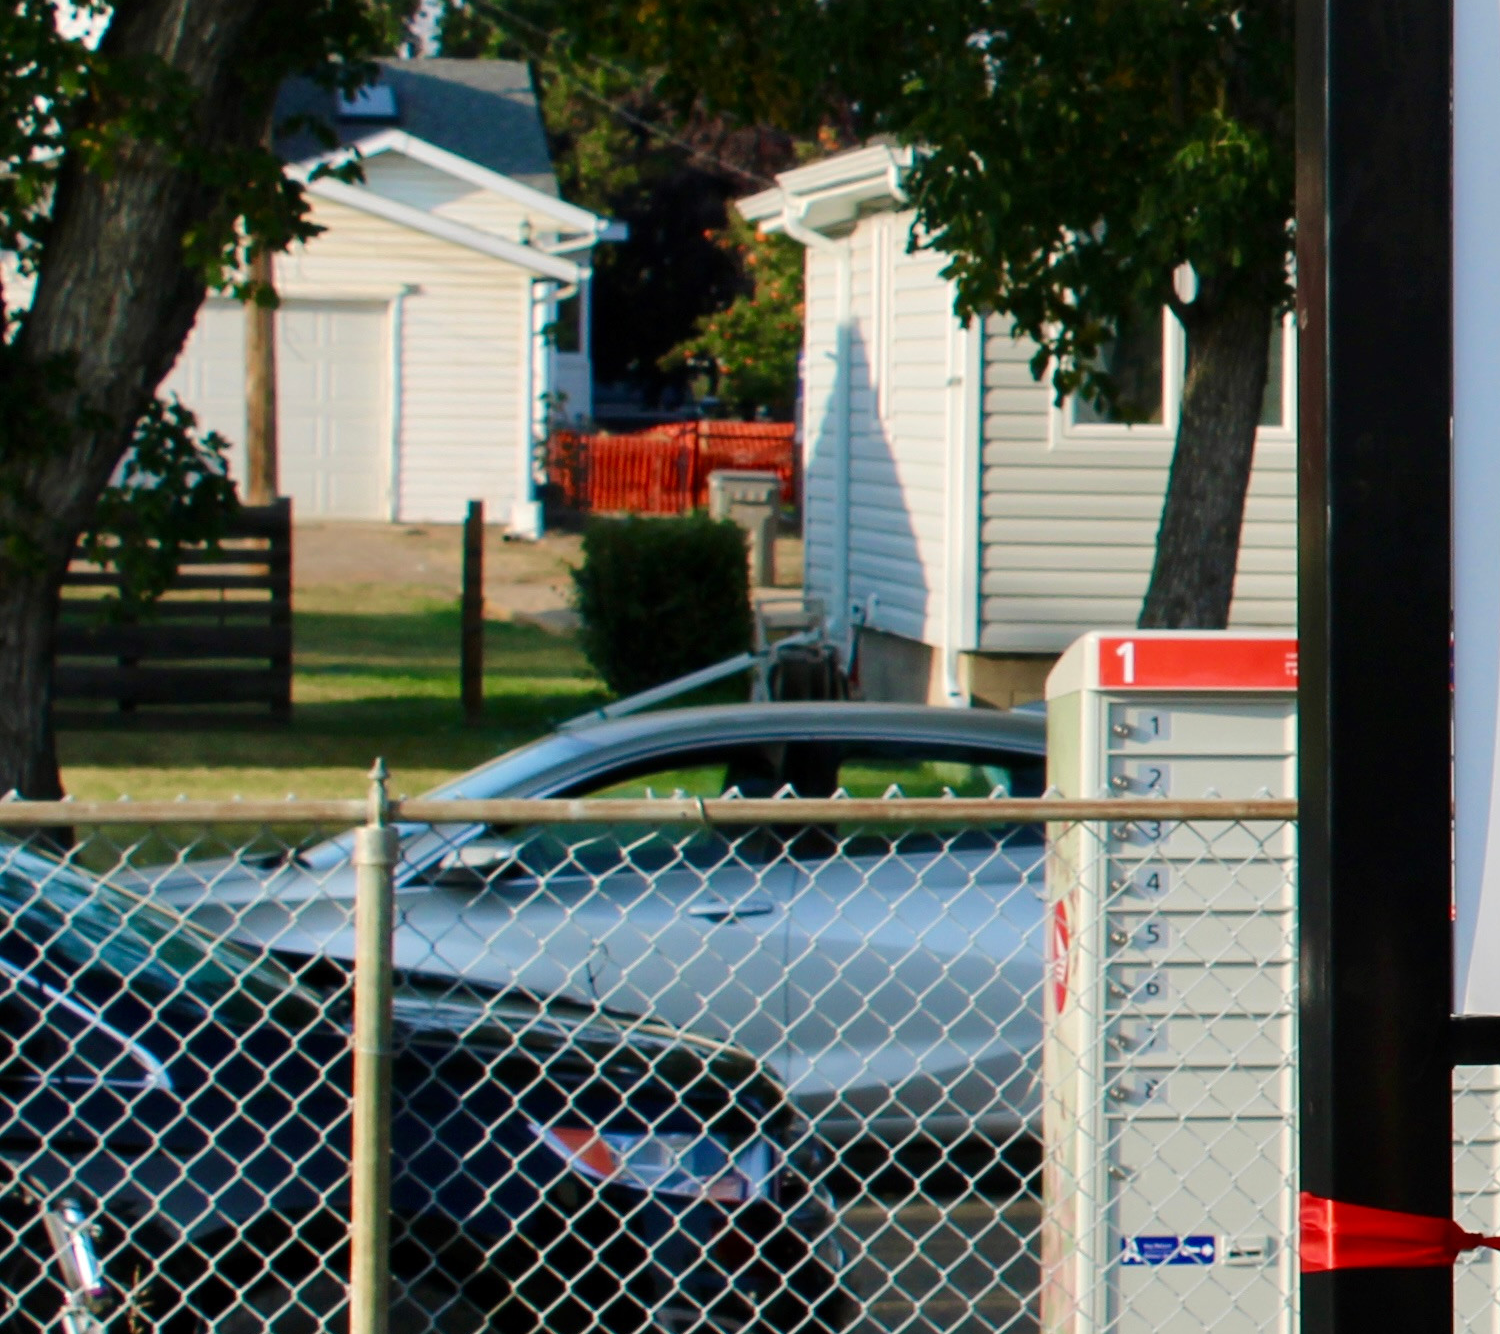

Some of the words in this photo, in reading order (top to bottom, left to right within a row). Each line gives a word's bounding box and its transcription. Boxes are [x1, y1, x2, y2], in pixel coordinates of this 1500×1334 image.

[1116, 642, 1135, 684] 1
[1150, 716, 1159, 735] 1
[1149, 769, 1161, 788] 2
[1150, 820, 1161, 840] 3
[1147, 873, 1160, 892] 4
[1149, 924, 1160, 944] 5
